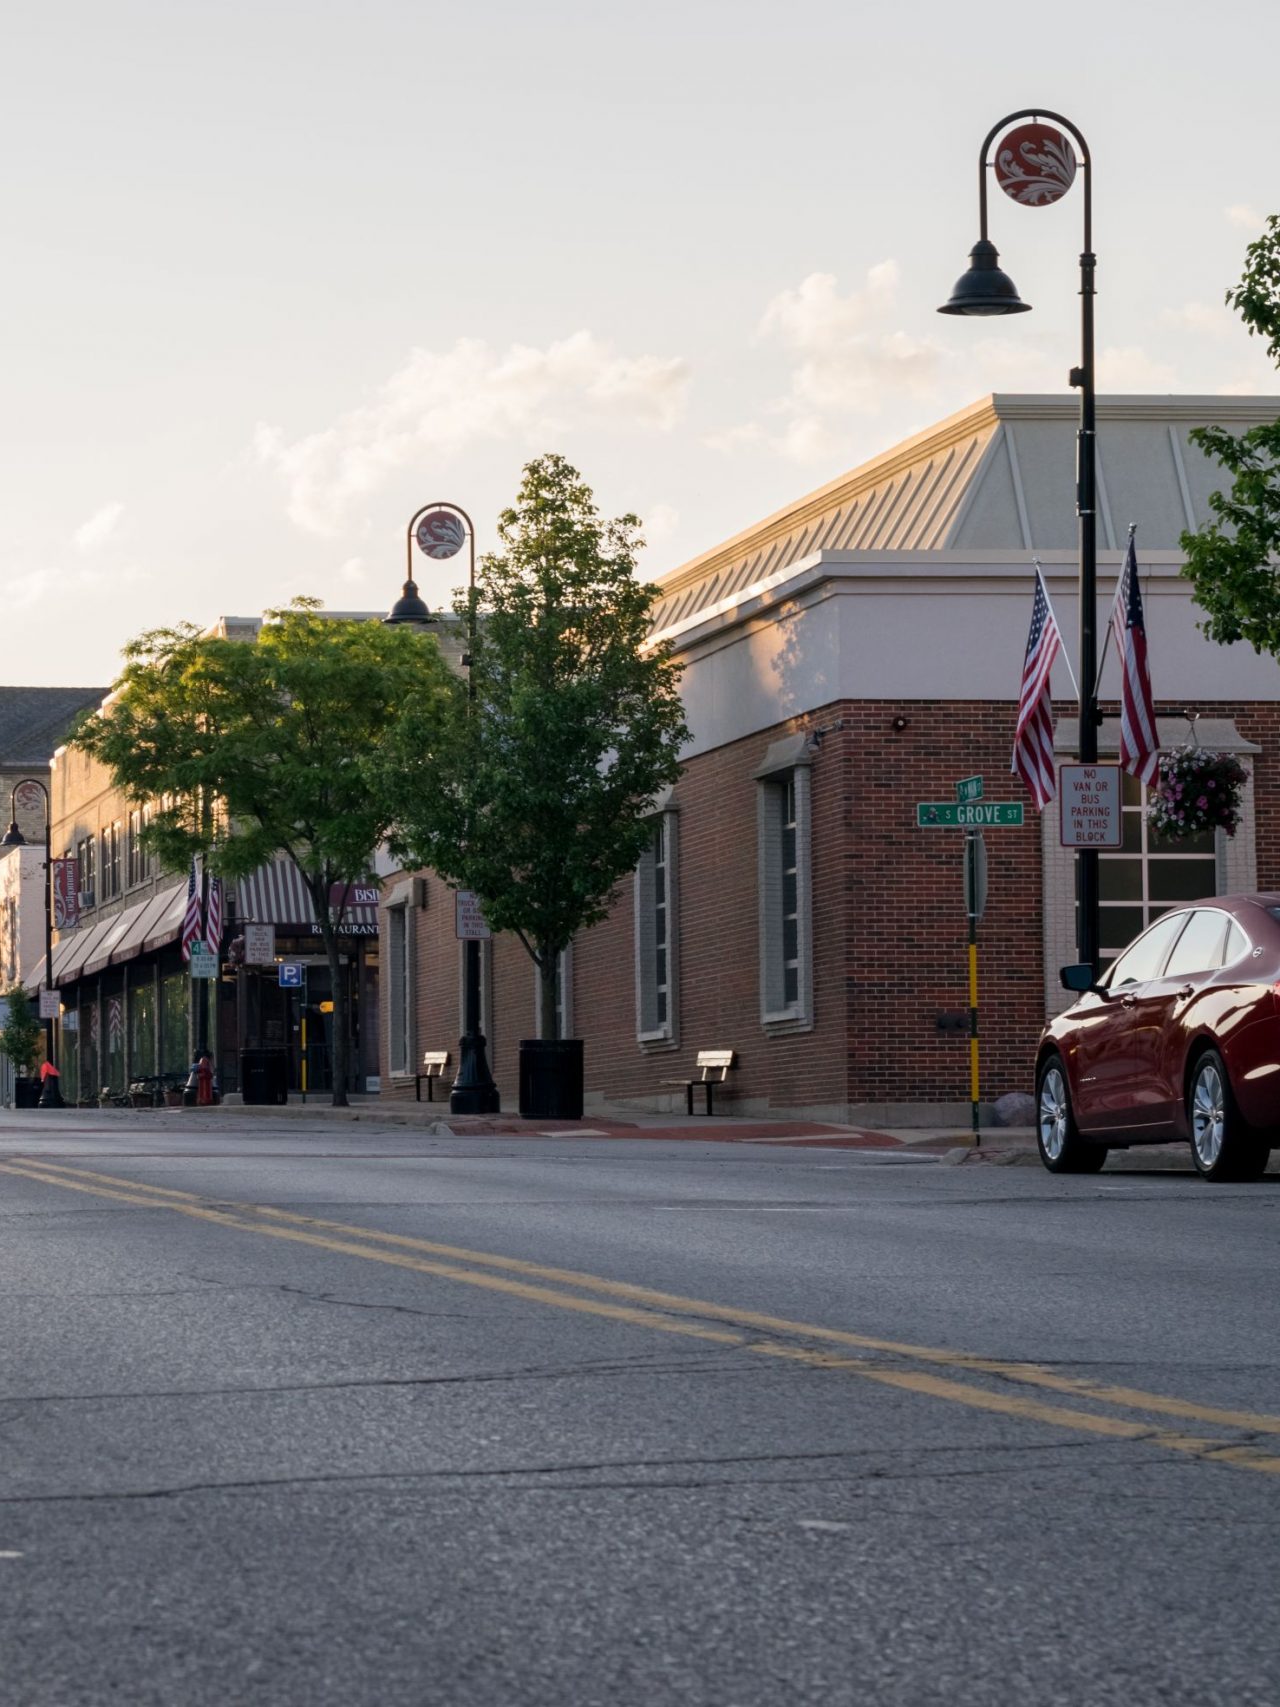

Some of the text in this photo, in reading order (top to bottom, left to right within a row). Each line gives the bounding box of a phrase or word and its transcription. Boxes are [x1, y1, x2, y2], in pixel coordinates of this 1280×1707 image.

[1084, 769, 1096, 779] NO
[1073, 782, 1108, 792] VAN OR
[1081, 794, 1100, 804] BUS
[945, 806, 1018, 823] S GROVE ST
[1071, 806, 1110, 817] PARKING
[1074, 819, 1108, 829] IN THIS
[1076, 831, 1106, 841] BLOCK
[284, 966, 297, 980] P
